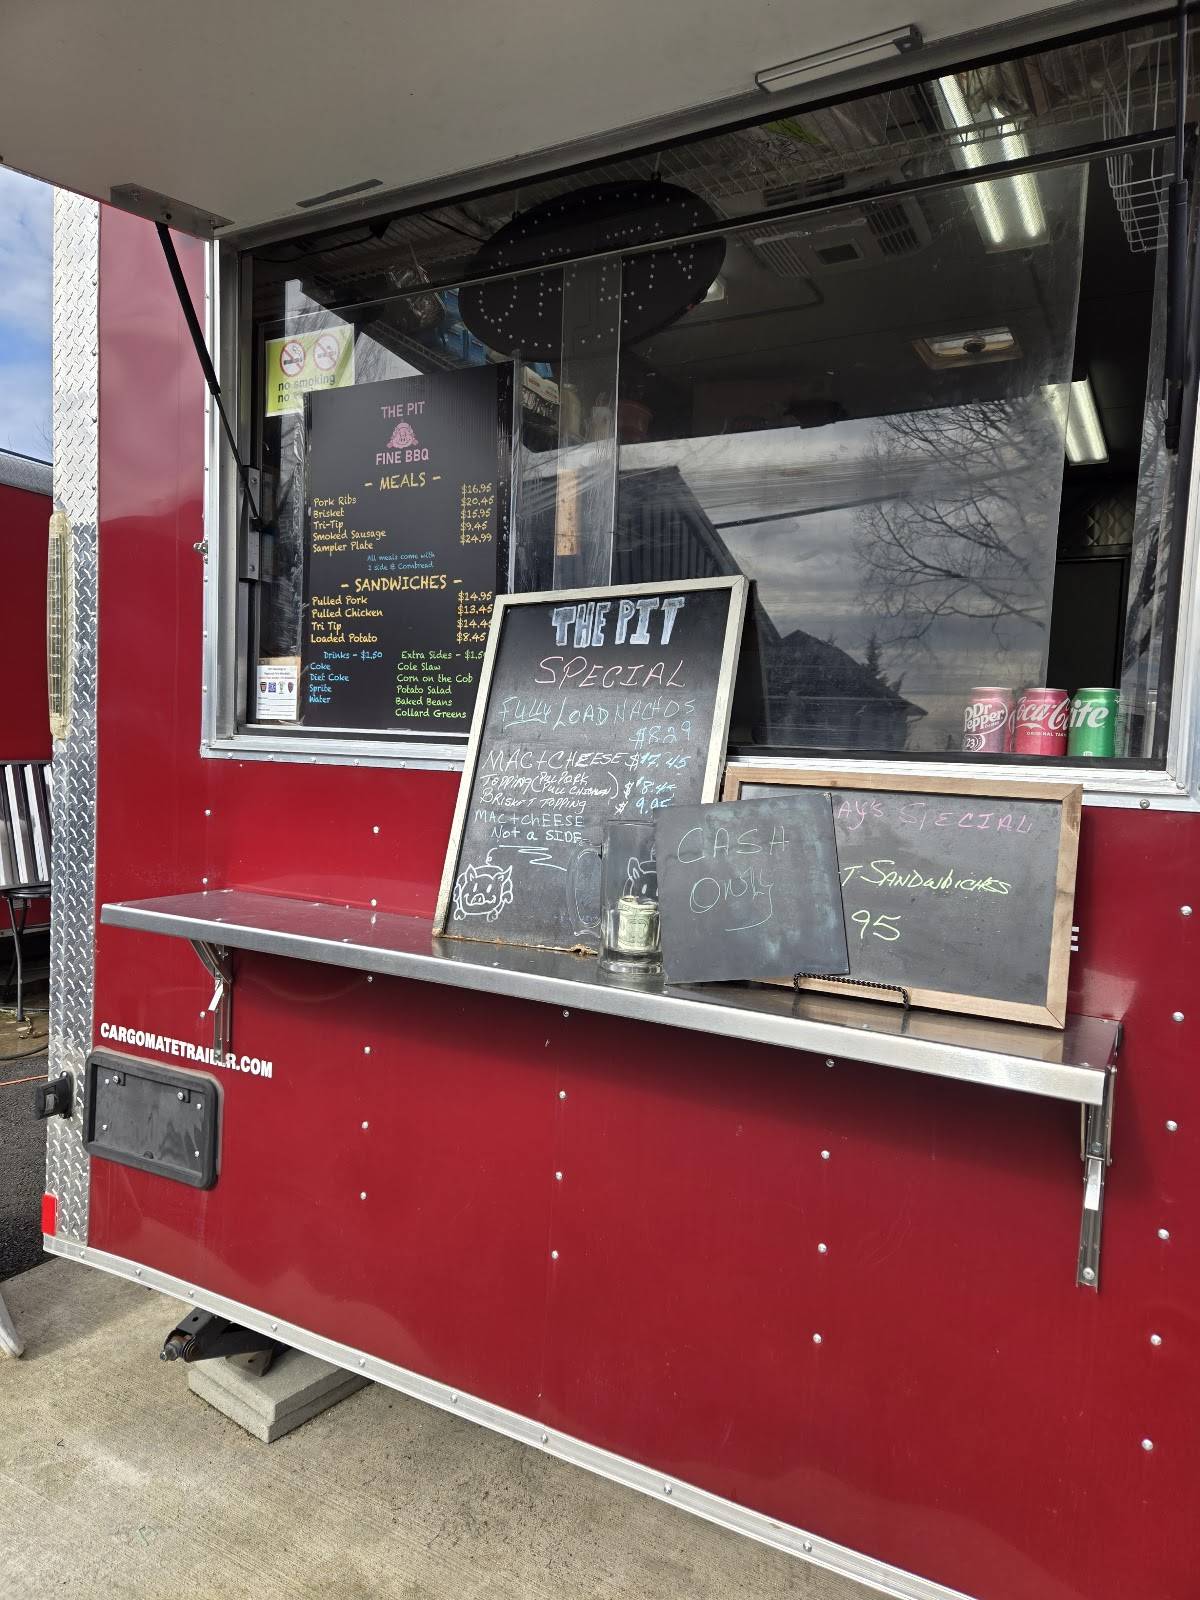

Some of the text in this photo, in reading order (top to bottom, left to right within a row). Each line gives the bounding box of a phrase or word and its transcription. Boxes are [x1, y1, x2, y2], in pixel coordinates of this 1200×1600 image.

[278, 374, 336, 392] no smoking
[277, 393, 290, 403] no
[380, 401, 426, 419] THE PIT
[375, 448, 429, 465] FINE BBQ
[379, 472, 426, 491] MEALS
[461, 483, 492, 497] $16.95
[313, 494, 357, 507] Pork Ribs
[460, 496, 495, 509] $20.45
[312, 507, 345, 518] Brisket
[460, 508, 492, 521] $15.95
[313, 520, 344, 533] Tri-Tip
[460, 521, 488, 533] $9.45
[312, 529, 387, 541] Smoked Sausage
[460, 533, 493, 546] $24.99
[312, 541, 374, 557] Sampler Plate
[367, 554, 377, 562] All
[420, 551, 435, 559] with
[374, 563, 388, 571] side
[354, 574, 448, 592] SANDWICHES
[312, 595, 368, 607] Pulled Pork
[458, 590, 493, 603] $14.95
[311, 607, 384, 619] Pulled Chicken
[457, 604, 494, 616] $13.45
[311, 621, 342, 635] Tri Tip
[552, 597, 685, 649] THE PIT
[311, 633, 378, 643] Loaded Potato
[456, 631, 487, 645] $8.45
[323, 651, 350, 659] Drinks
[360, 650, 384, 661] $1.50
[401, 651, 426, 659] Extra
[429, 651, 453, 659] Sides
[464, 649, 487, 662] $1.5
[310, 662, 331, 671] Coke
[397, 662, 441, 671] Cole Slaw
[534, 655, 686, 690] SPECIAL
[309, 673, 350, 682] Diet Coke
[396, 674, 419, 683] Corn
[437, 673, 452, 683] the
[455, 673, 474, 684] Cob
[309, 684, 332, 695] Sprite
[396, 685, 452, 694] Potato Salad
[309, 695, 331, 704] Water
[395, 697, 453, 706] Baked Beans
[395, 709, 467, 719] Collard Greens
[552, 697, 609, 730] LOAD
[613, 696, 696, 724] NACHOS
[973, 703, 993, 717] Dr
[963, 708, 1005, 732] Pepper
[899, 802, 1033, 833] SPECIAL
[491, 826, 583, 843] Not a SIDE
[677, 825, 790, 864] CASH
[100, 1022, 273, 1078] CARGOMATETRAILR.COM
